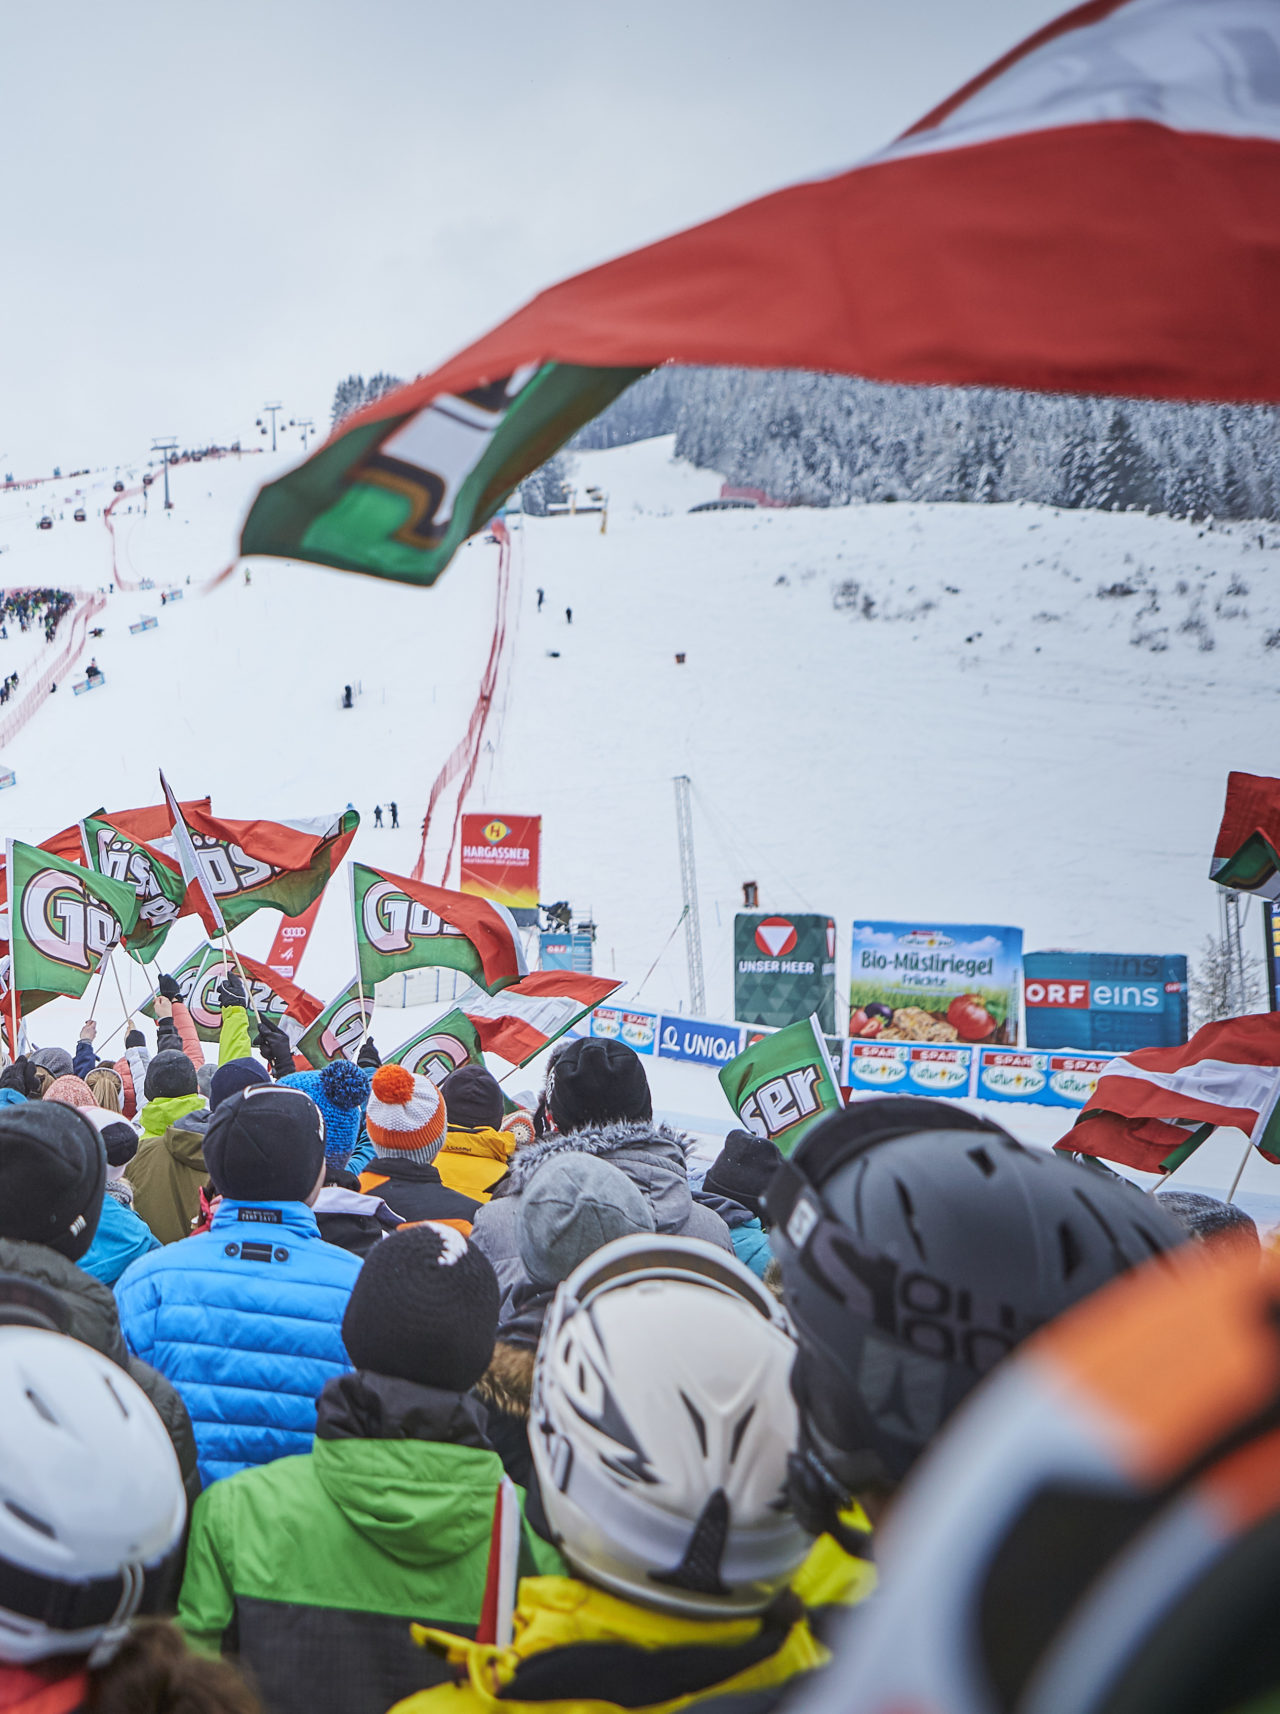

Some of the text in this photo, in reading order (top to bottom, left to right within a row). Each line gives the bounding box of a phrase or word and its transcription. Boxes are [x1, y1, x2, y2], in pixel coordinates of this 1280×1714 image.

[463, 846, 530, 859] HARGASSNER
[739, 960, 779, 974] UNSER
[780, 961, 815, 975] HEER
[860, 951, 995, 978] Bio-Müsliriegel
[1025, 983, 1160, 1007] ORF eins
[683, 1032, 736, 1060] UNIQA
[861, 1047, 896, 1059] SPAR
[919, 1050, 957, 1063] SPAR
[993, 1055, 1032, 1068] SPAR
